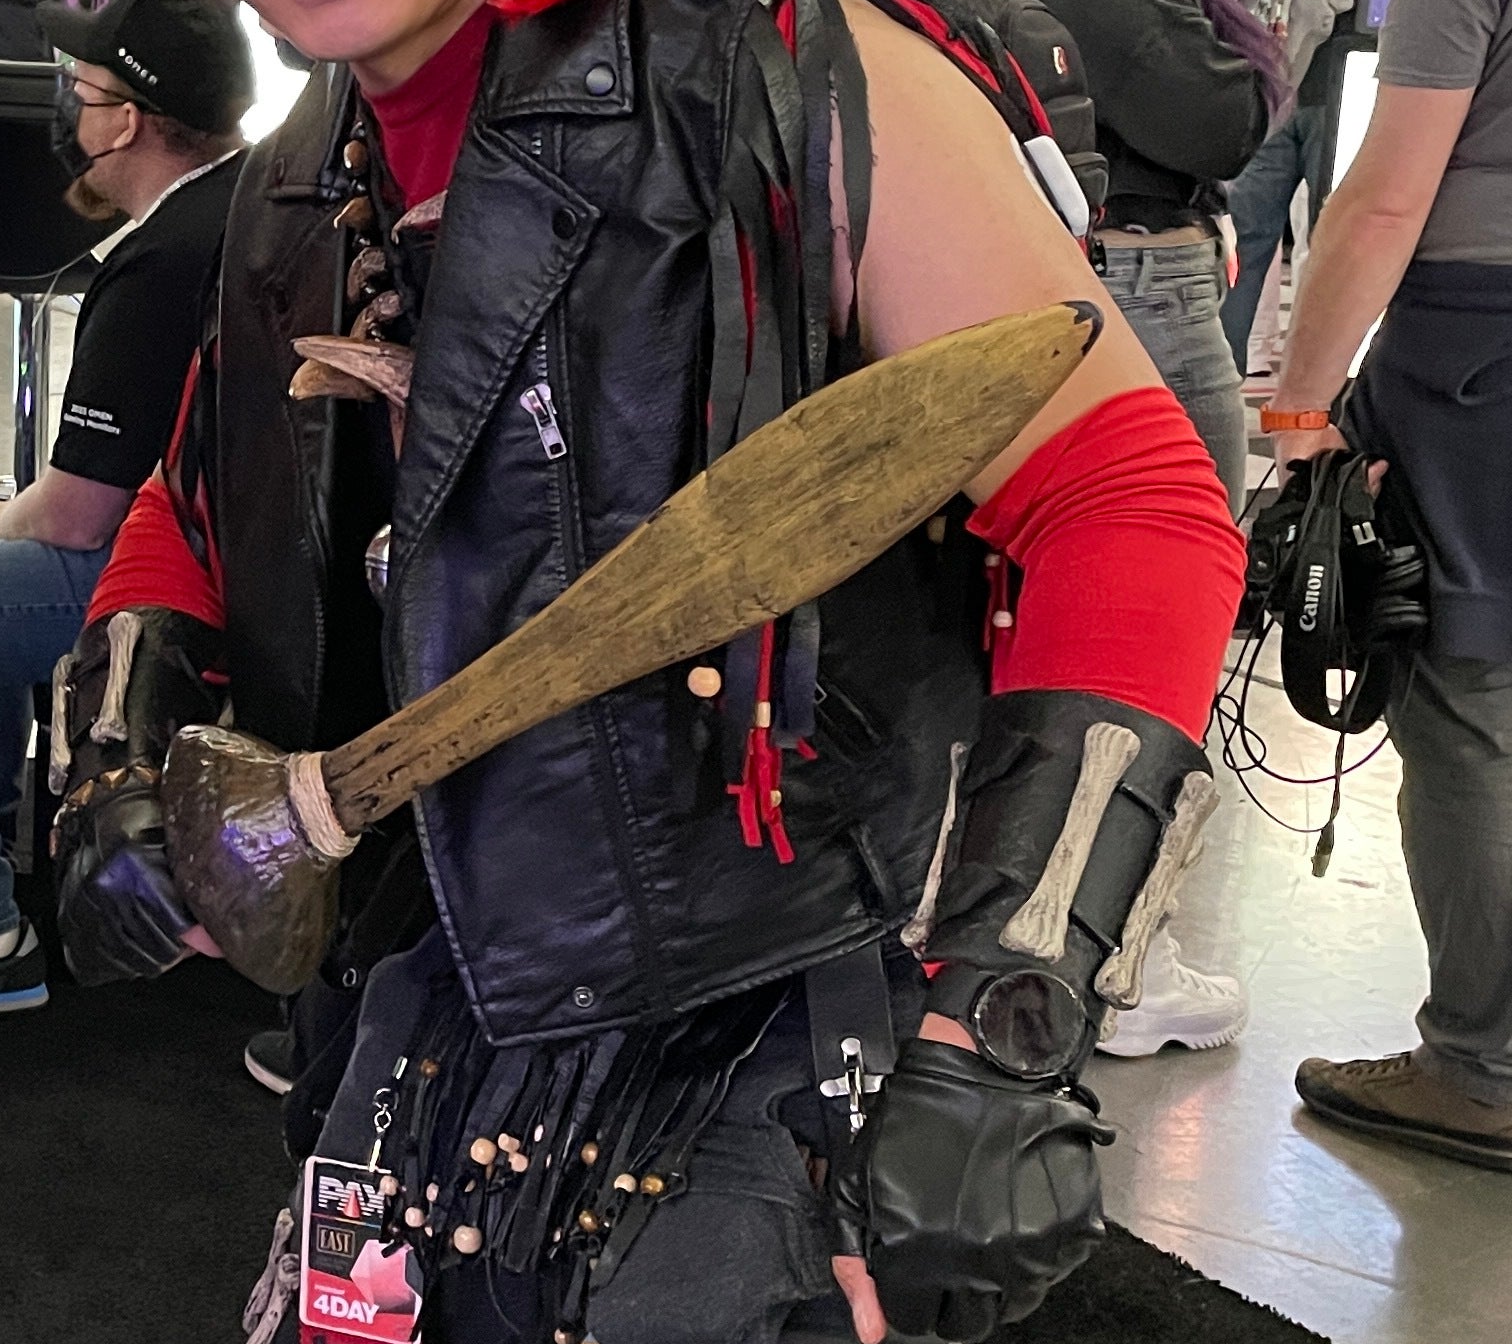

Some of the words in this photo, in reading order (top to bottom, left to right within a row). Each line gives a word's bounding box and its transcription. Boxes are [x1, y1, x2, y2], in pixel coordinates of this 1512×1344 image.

[1299, 565, 1324, 632] Canon
[319, 1228, 351, 1253] EAST
[313, 1294, 380, 1325] 4DAY
